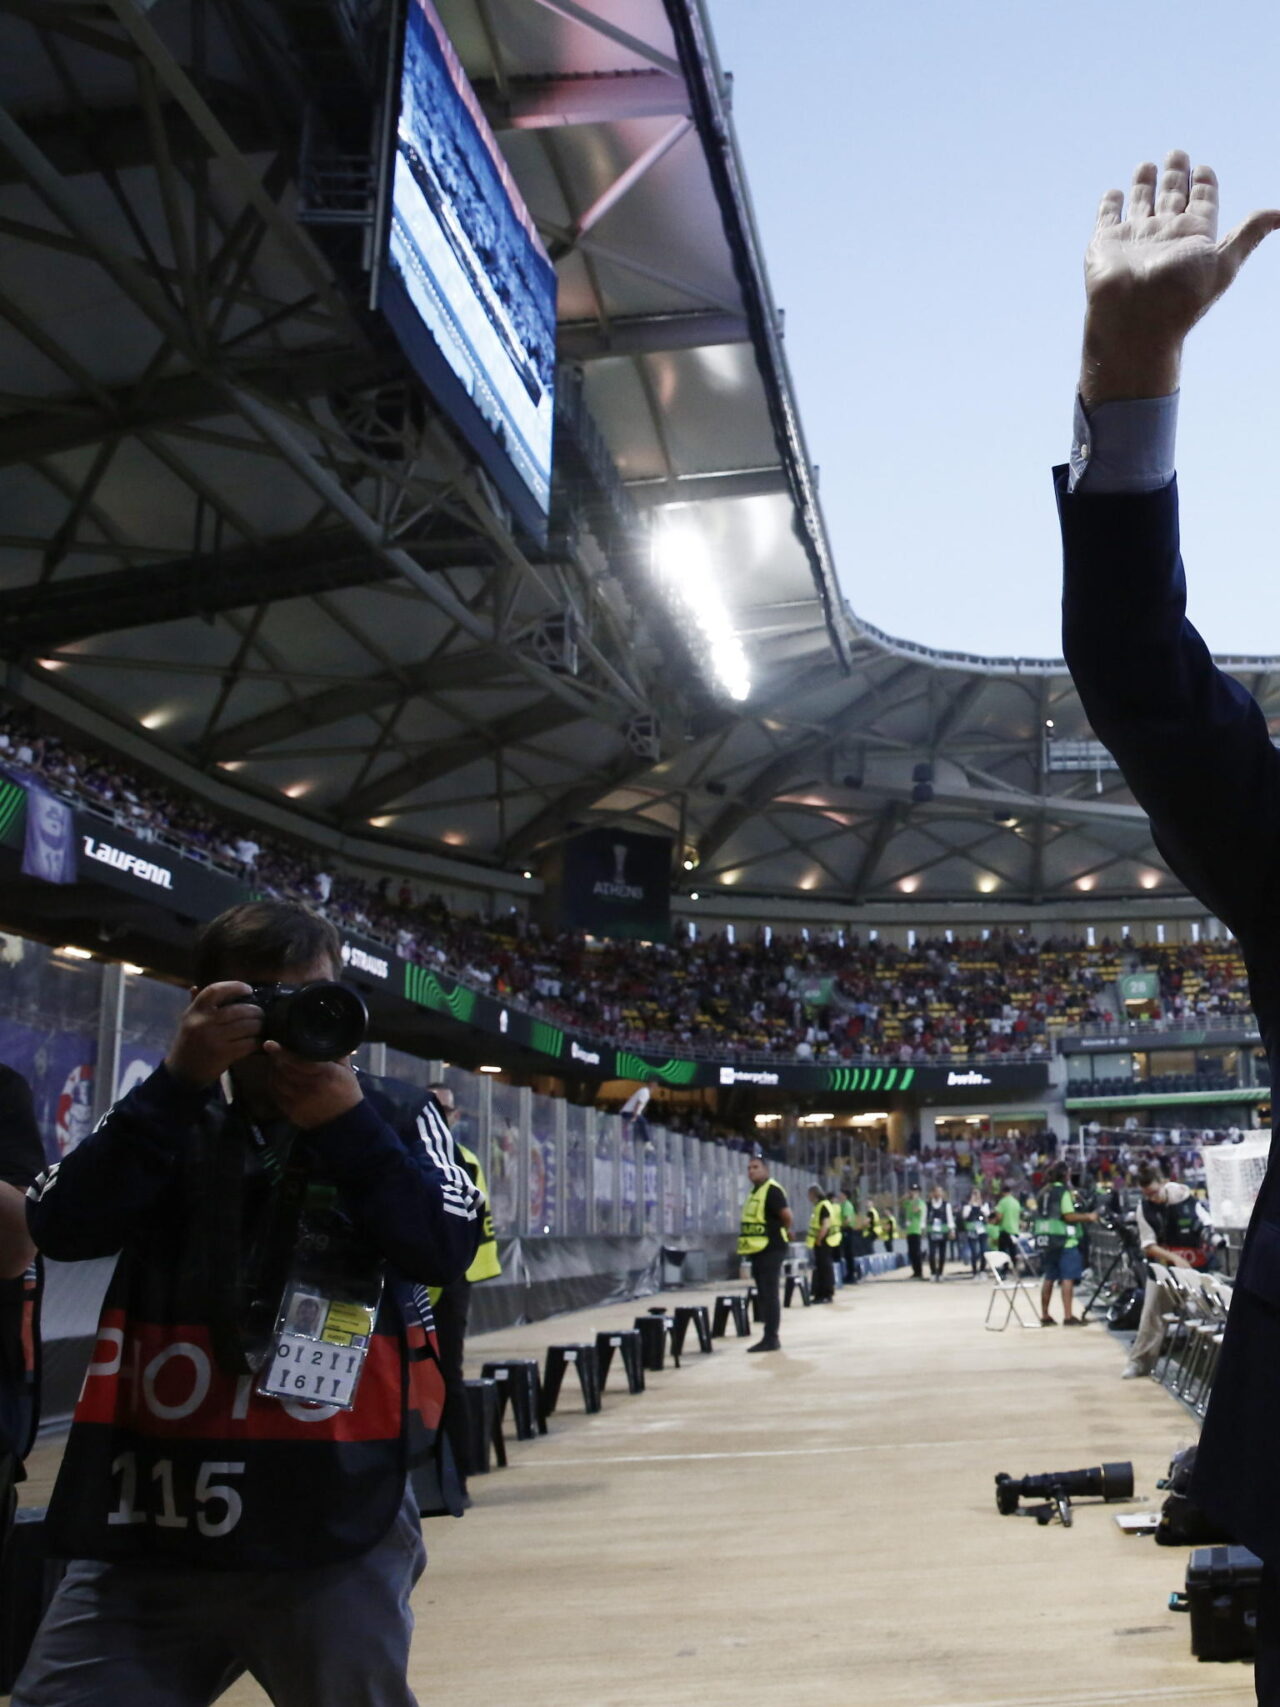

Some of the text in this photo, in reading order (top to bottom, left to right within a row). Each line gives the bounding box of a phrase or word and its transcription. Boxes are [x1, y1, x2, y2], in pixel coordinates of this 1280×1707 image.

[83, 835, 174, 890] Laufenn
[78, 1326, 341, 1422] PHO
[107, 1449, 247, 1538] 115
